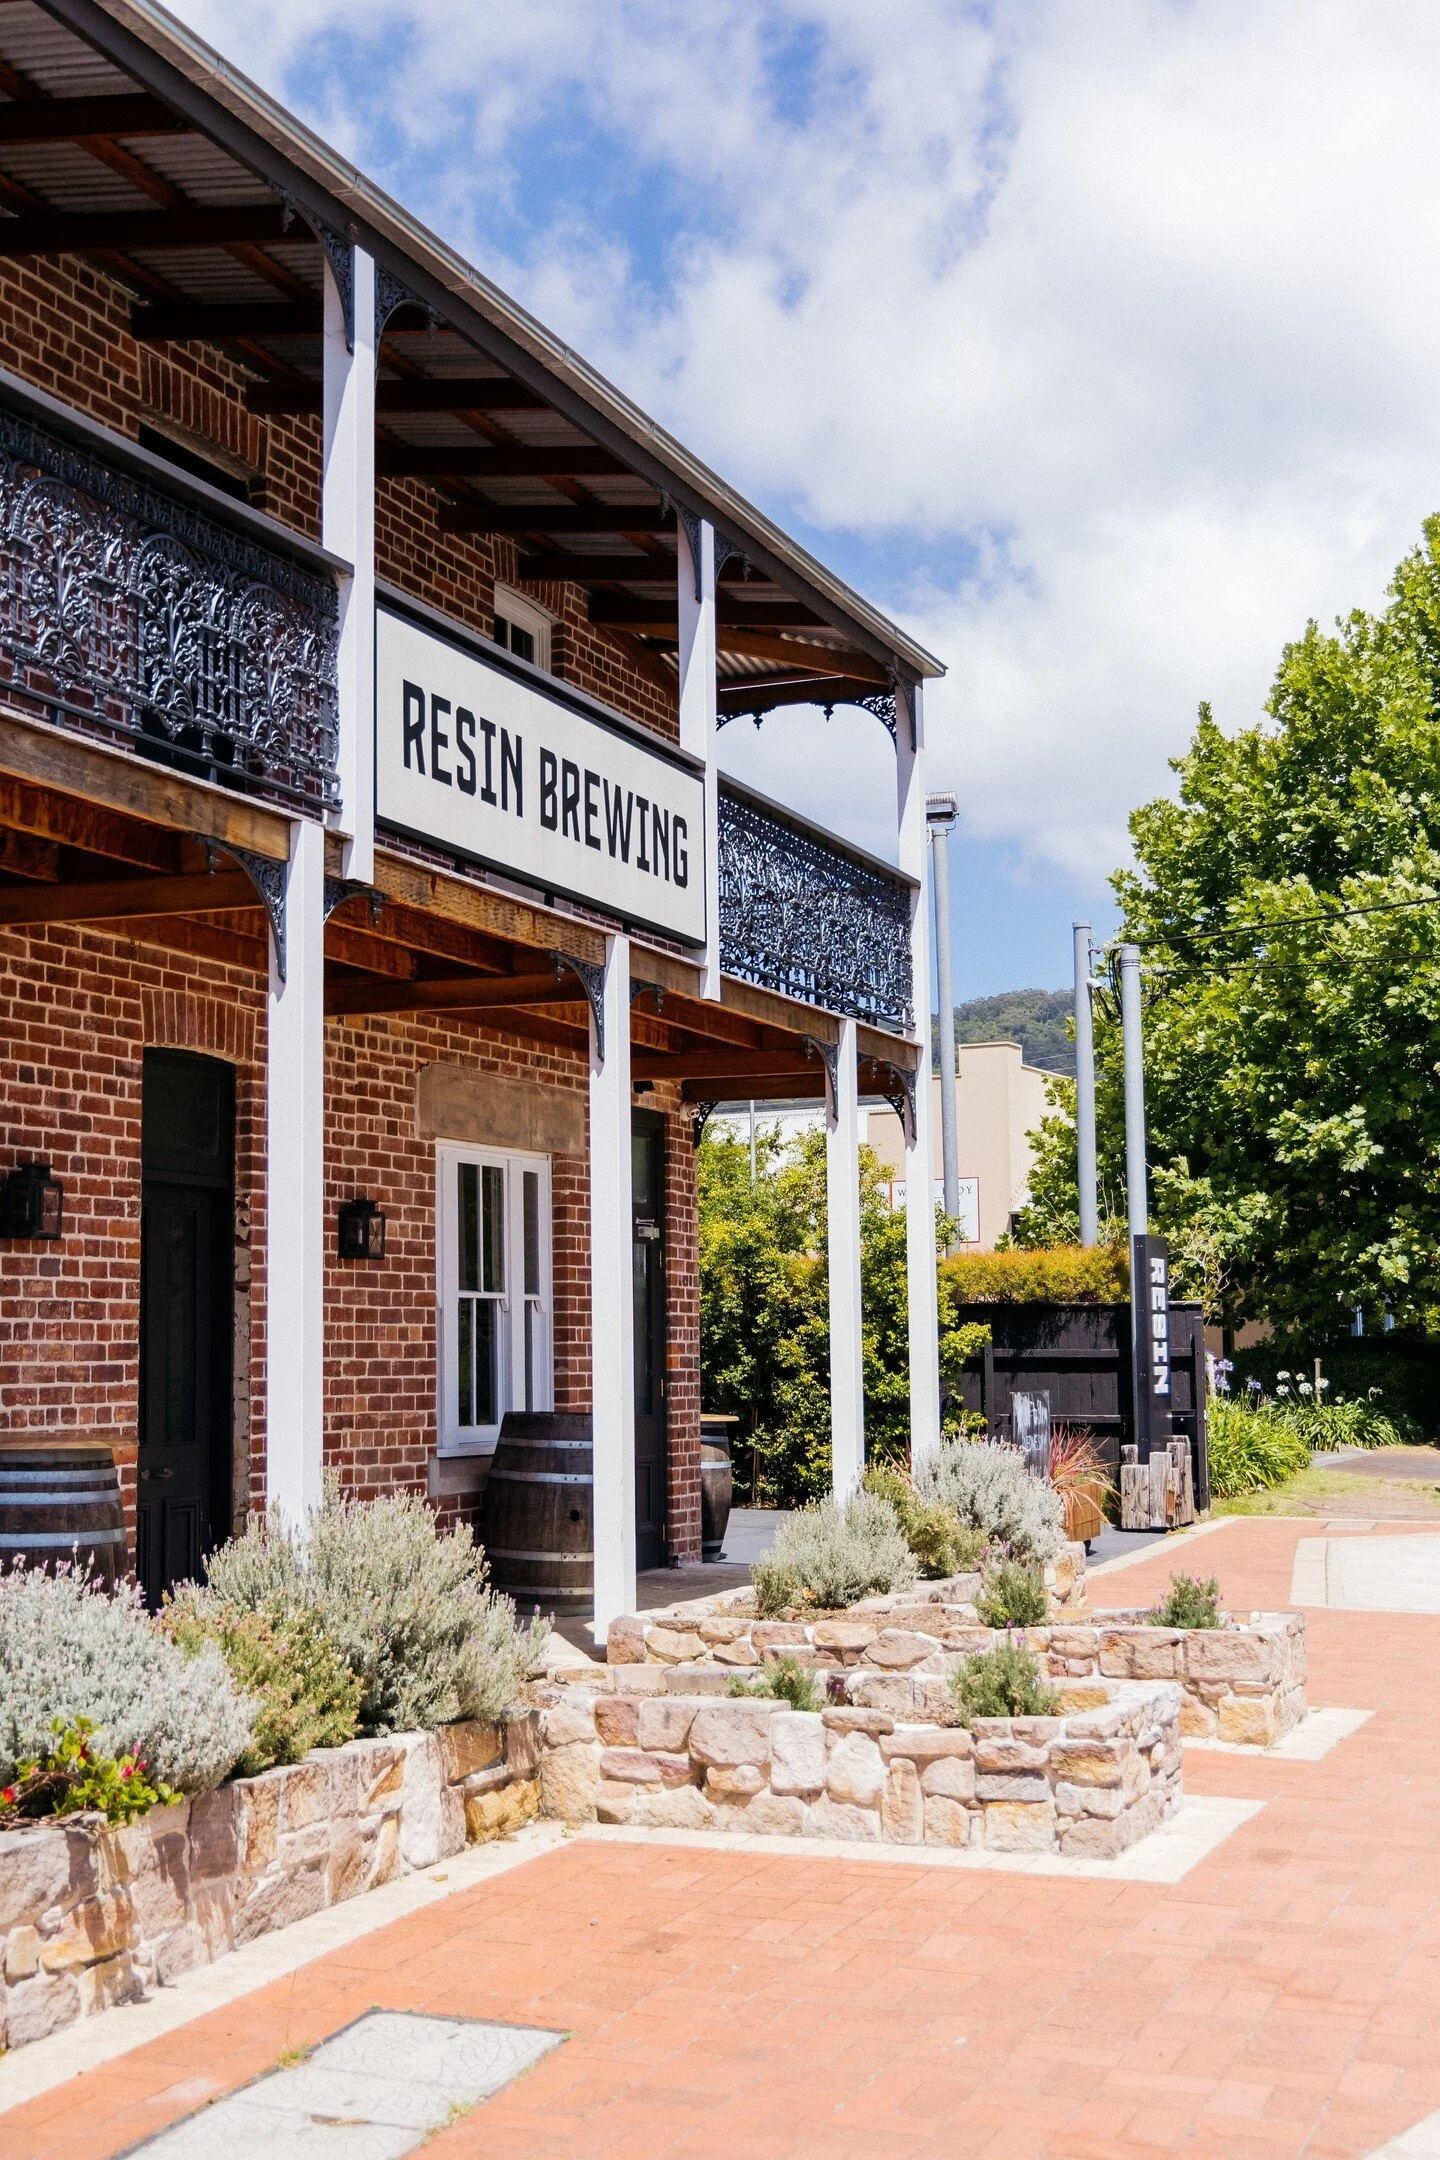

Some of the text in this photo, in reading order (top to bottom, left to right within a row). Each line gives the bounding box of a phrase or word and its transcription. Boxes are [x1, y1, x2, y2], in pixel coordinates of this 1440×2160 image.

[403, 678, 688, 889] RESIN BREWING
[1150, 1257, 1168, 1394] RESIN
